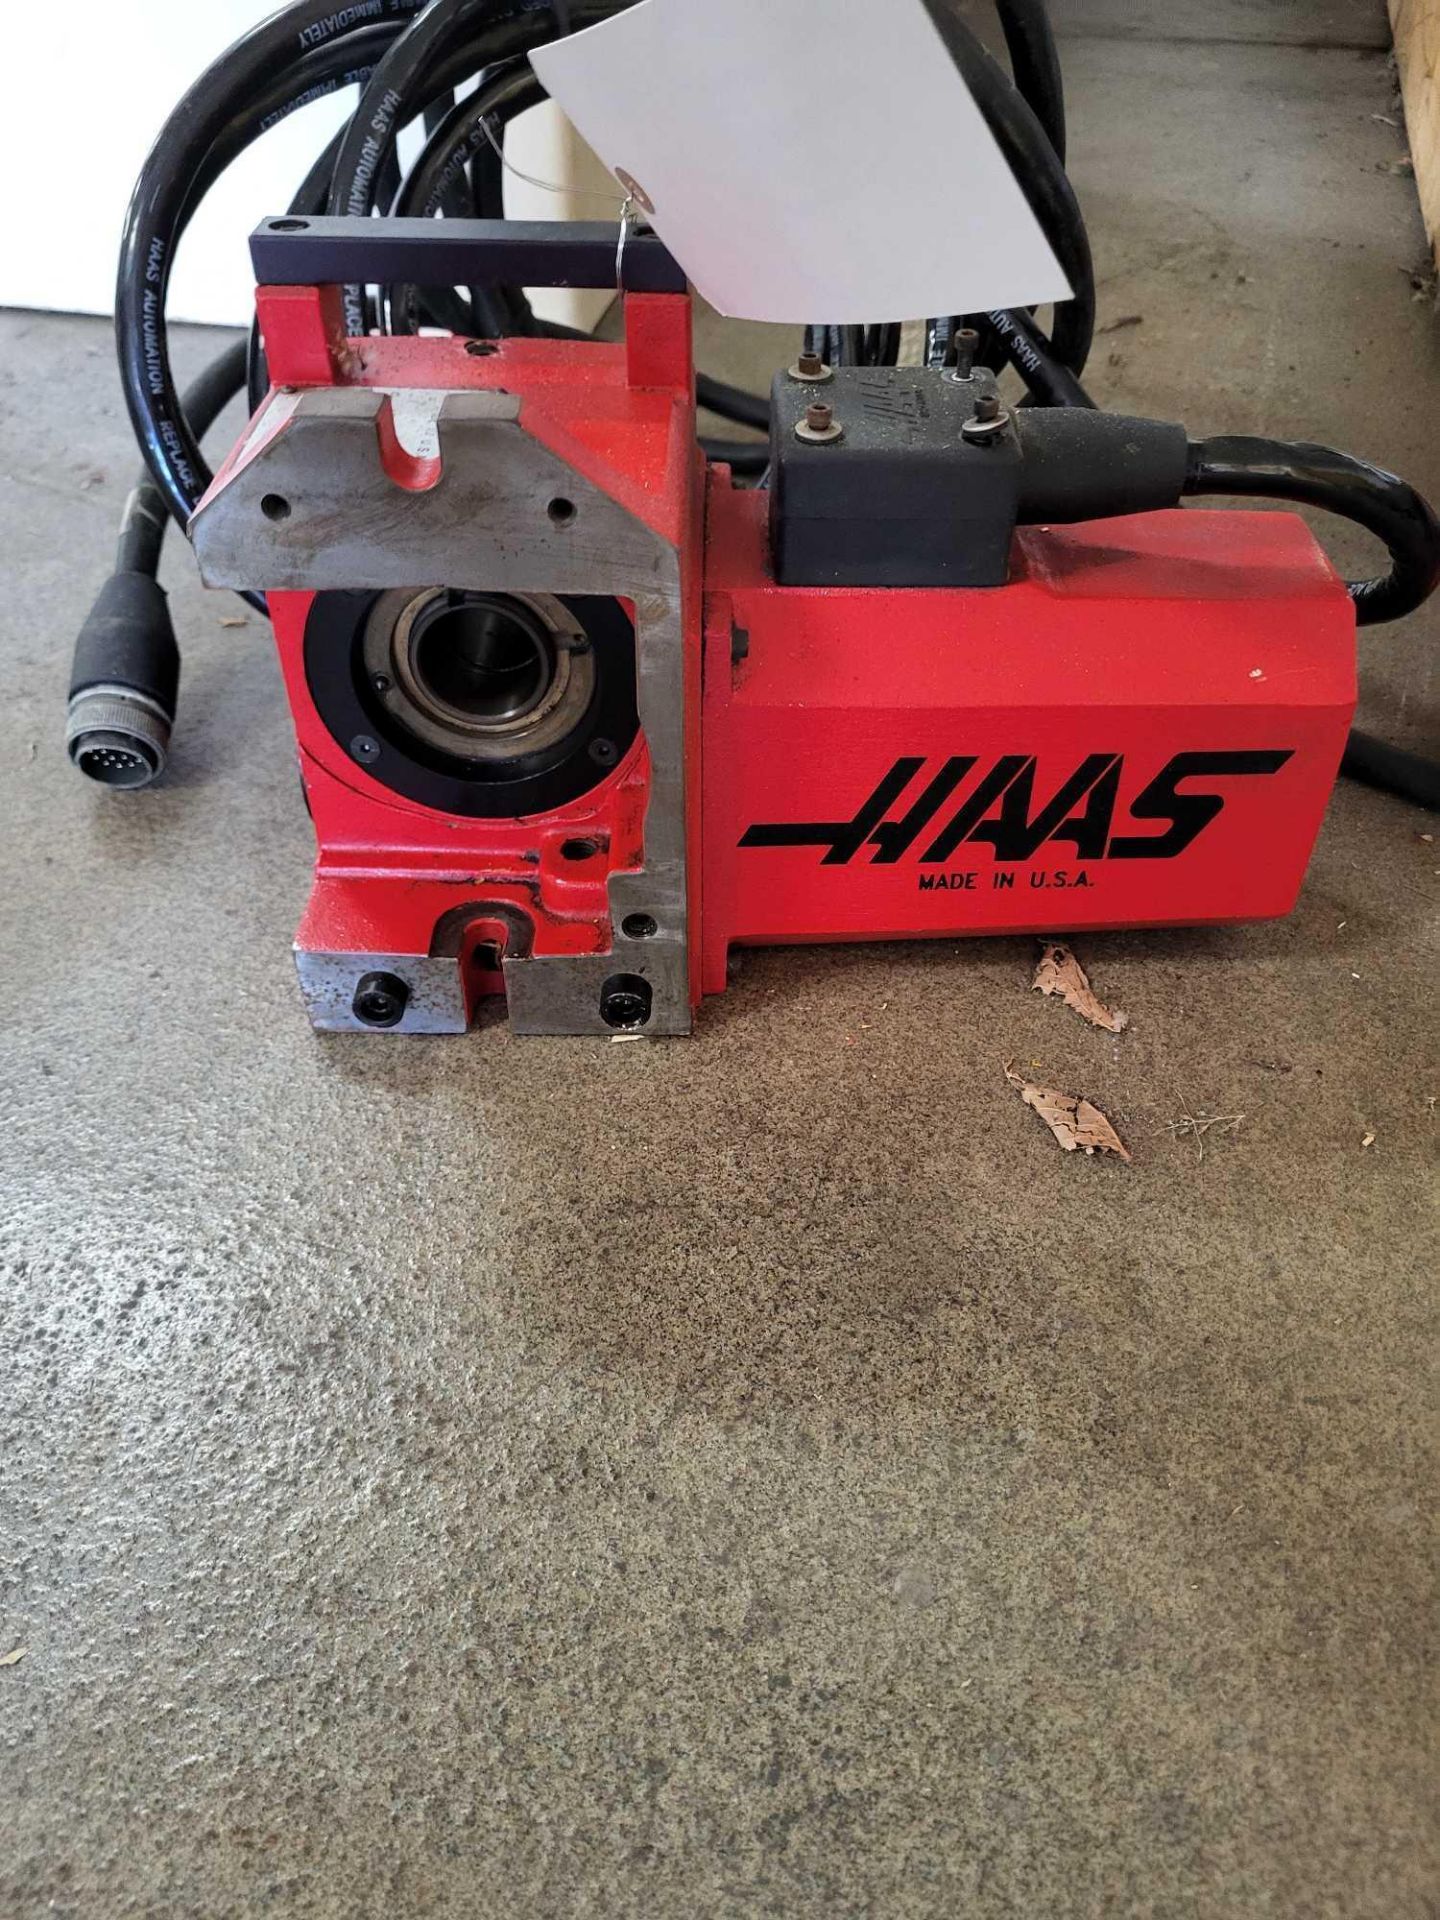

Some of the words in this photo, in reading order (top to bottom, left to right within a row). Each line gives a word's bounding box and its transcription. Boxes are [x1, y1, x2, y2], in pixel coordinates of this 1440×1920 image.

[371, 89, 402, 133] HAAS
[145, 236, 166, 283] HAAS
[343, 284, 364, 336] PLACE
[987, 310, 1014, 334] AUT
[142, 288, 165, 395] AUTOMATION
[1011, 335, 1041, 373] HAAS
[160, 420, 195, 490] REPLACE
[737, 749, 1296, 865] HAAS
[918, 872, 978, 890] MADE
[993, 872, 1015, 889] IN
[1030, 870, 1095, 889] U.S.A.
